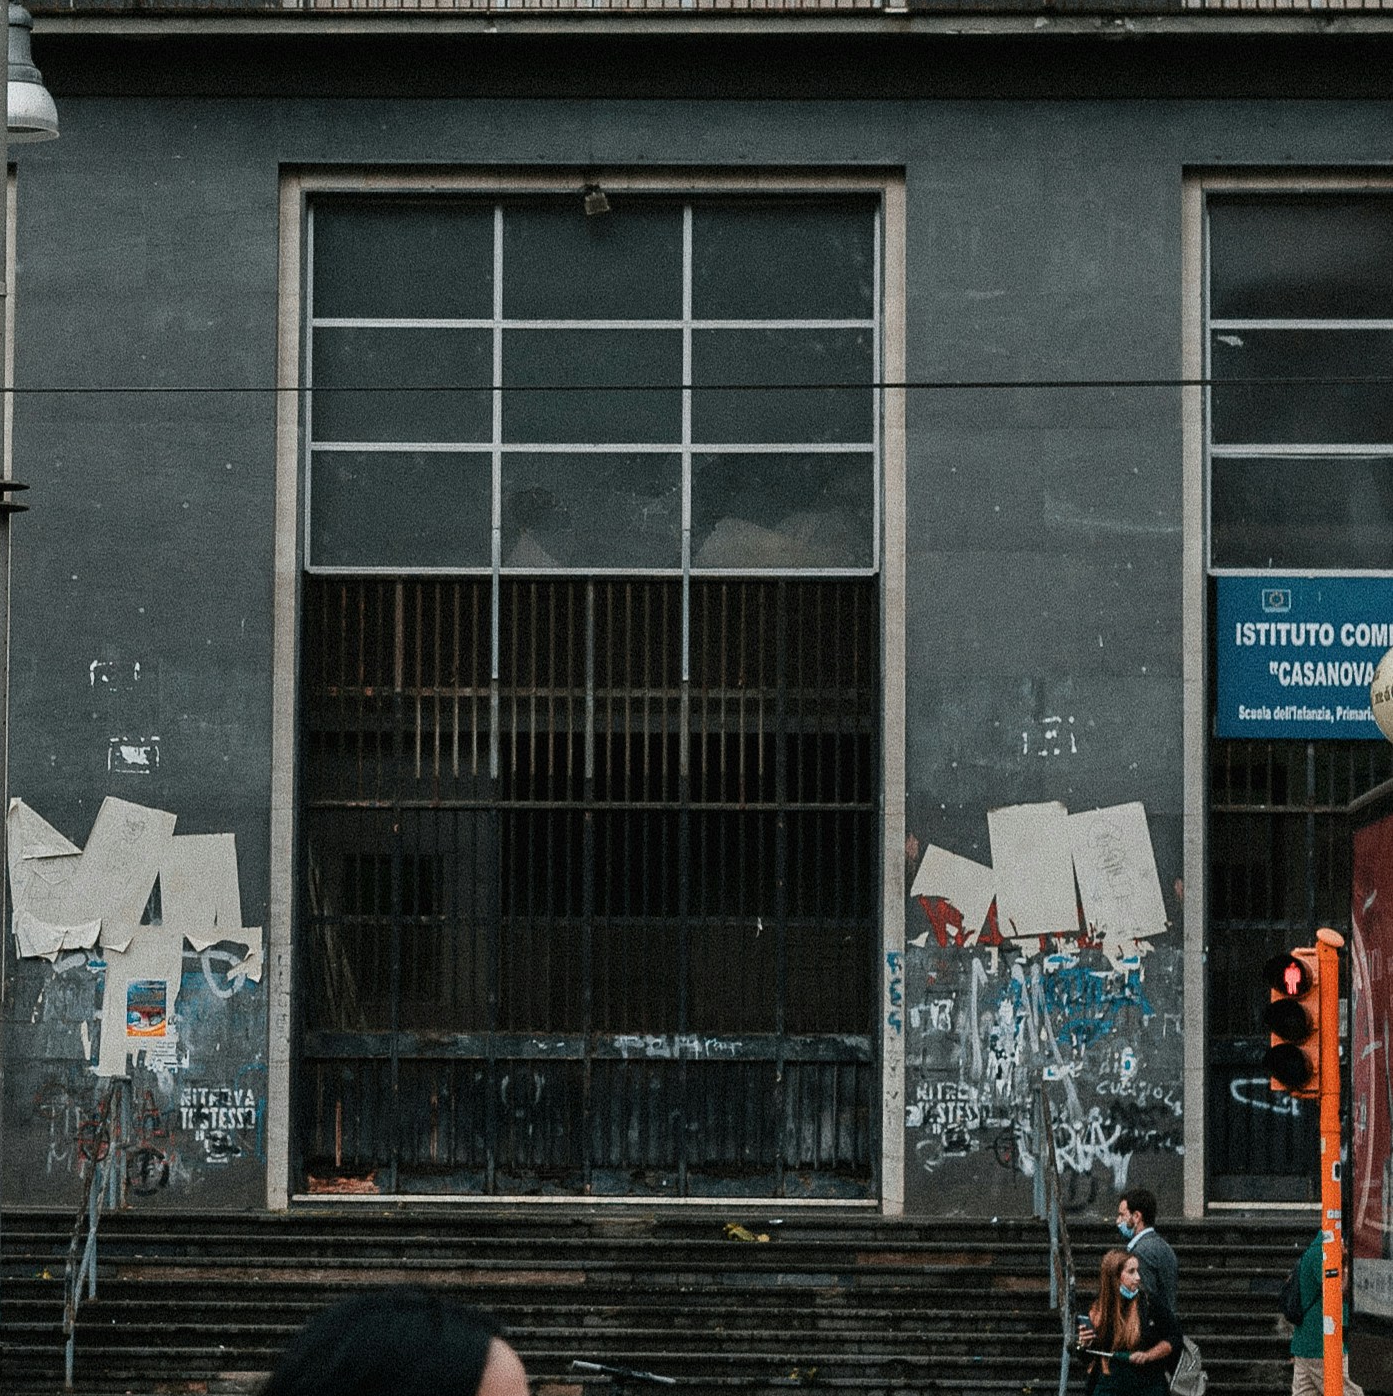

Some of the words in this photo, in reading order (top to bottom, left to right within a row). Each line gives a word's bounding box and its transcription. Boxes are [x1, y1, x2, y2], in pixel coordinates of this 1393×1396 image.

[1235, 622, 1335, 647] ISTITUTO
[1340, 622, 1393, 648] COM
[1238, 705, 1272, 721] Scuola
